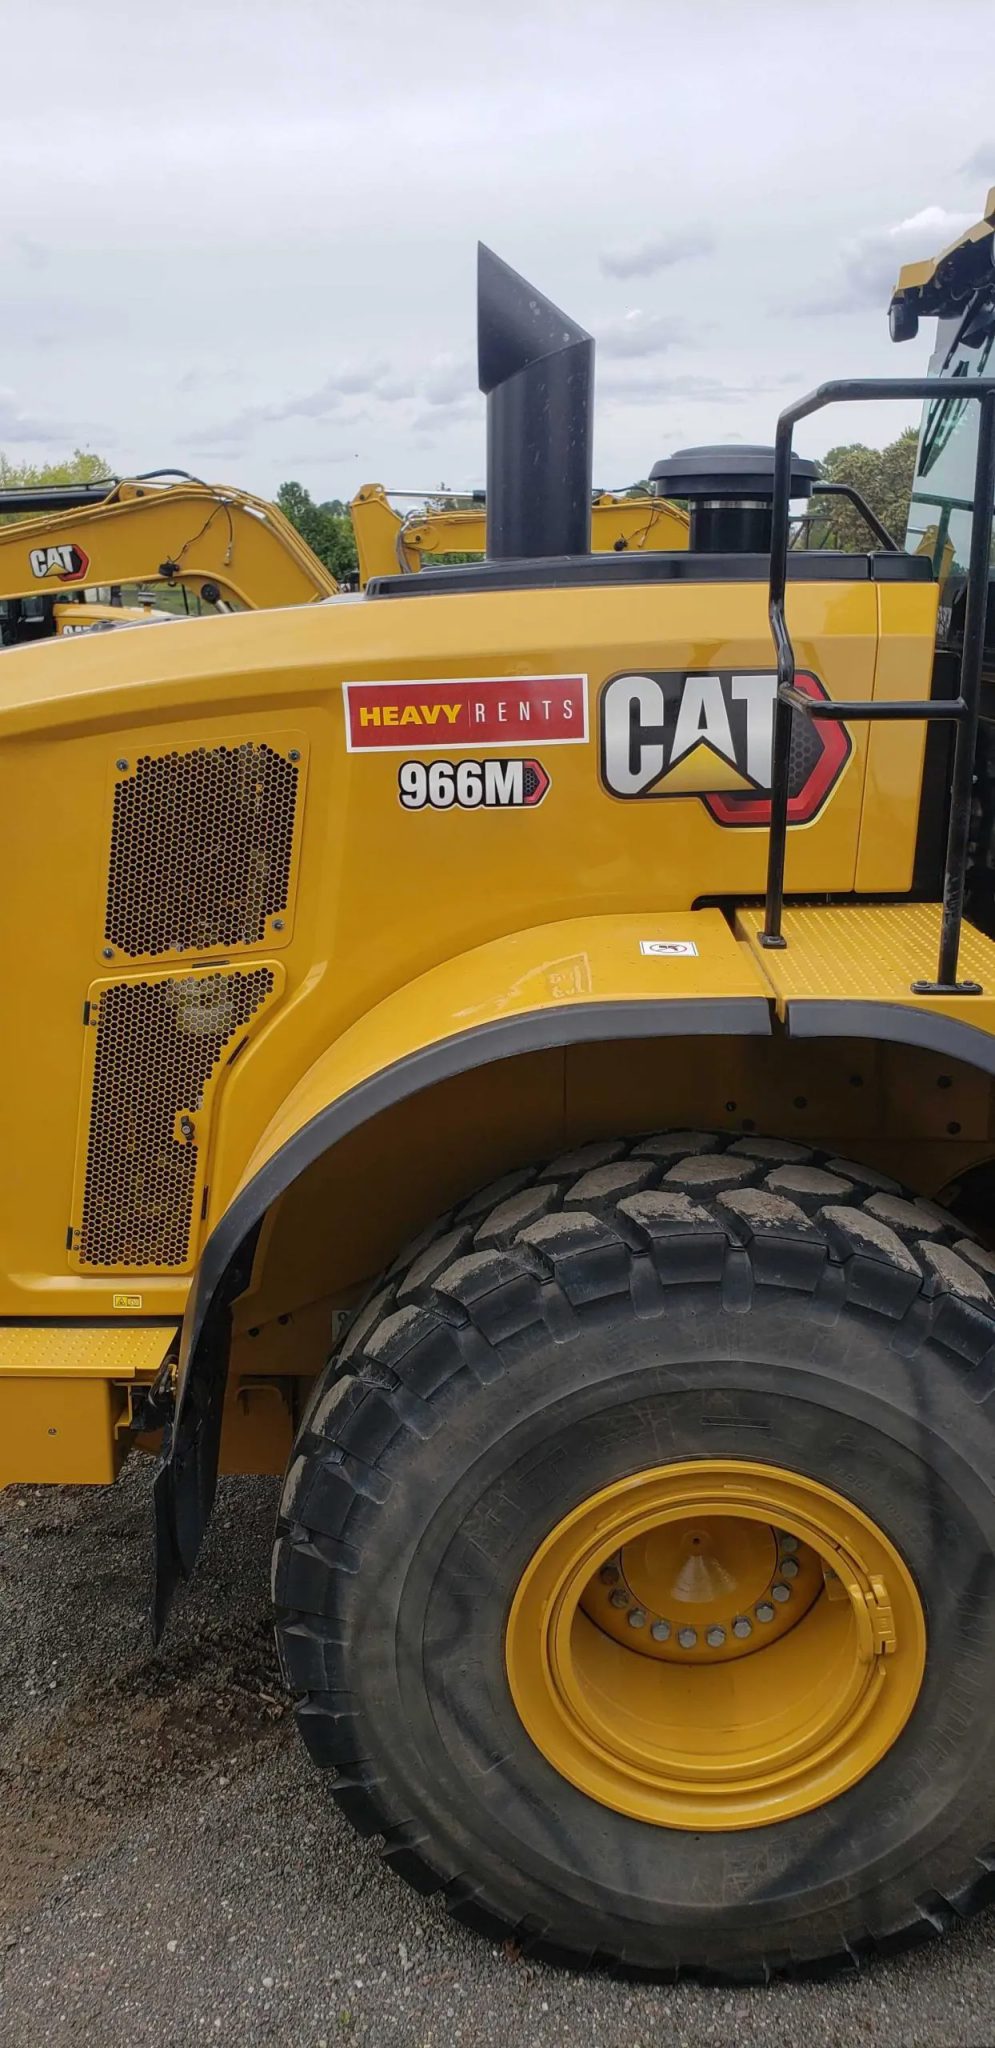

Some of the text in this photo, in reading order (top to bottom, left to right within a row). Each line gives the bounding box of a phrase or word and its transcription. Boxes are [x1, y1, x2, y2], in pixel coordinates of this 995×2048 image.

[30, 546, 73, 577] CAT
[359, 700, 572, 726] HEAVY RENTS
[605, 675, 778, 794] CAT
[401, 761, 523, 807] 966M
